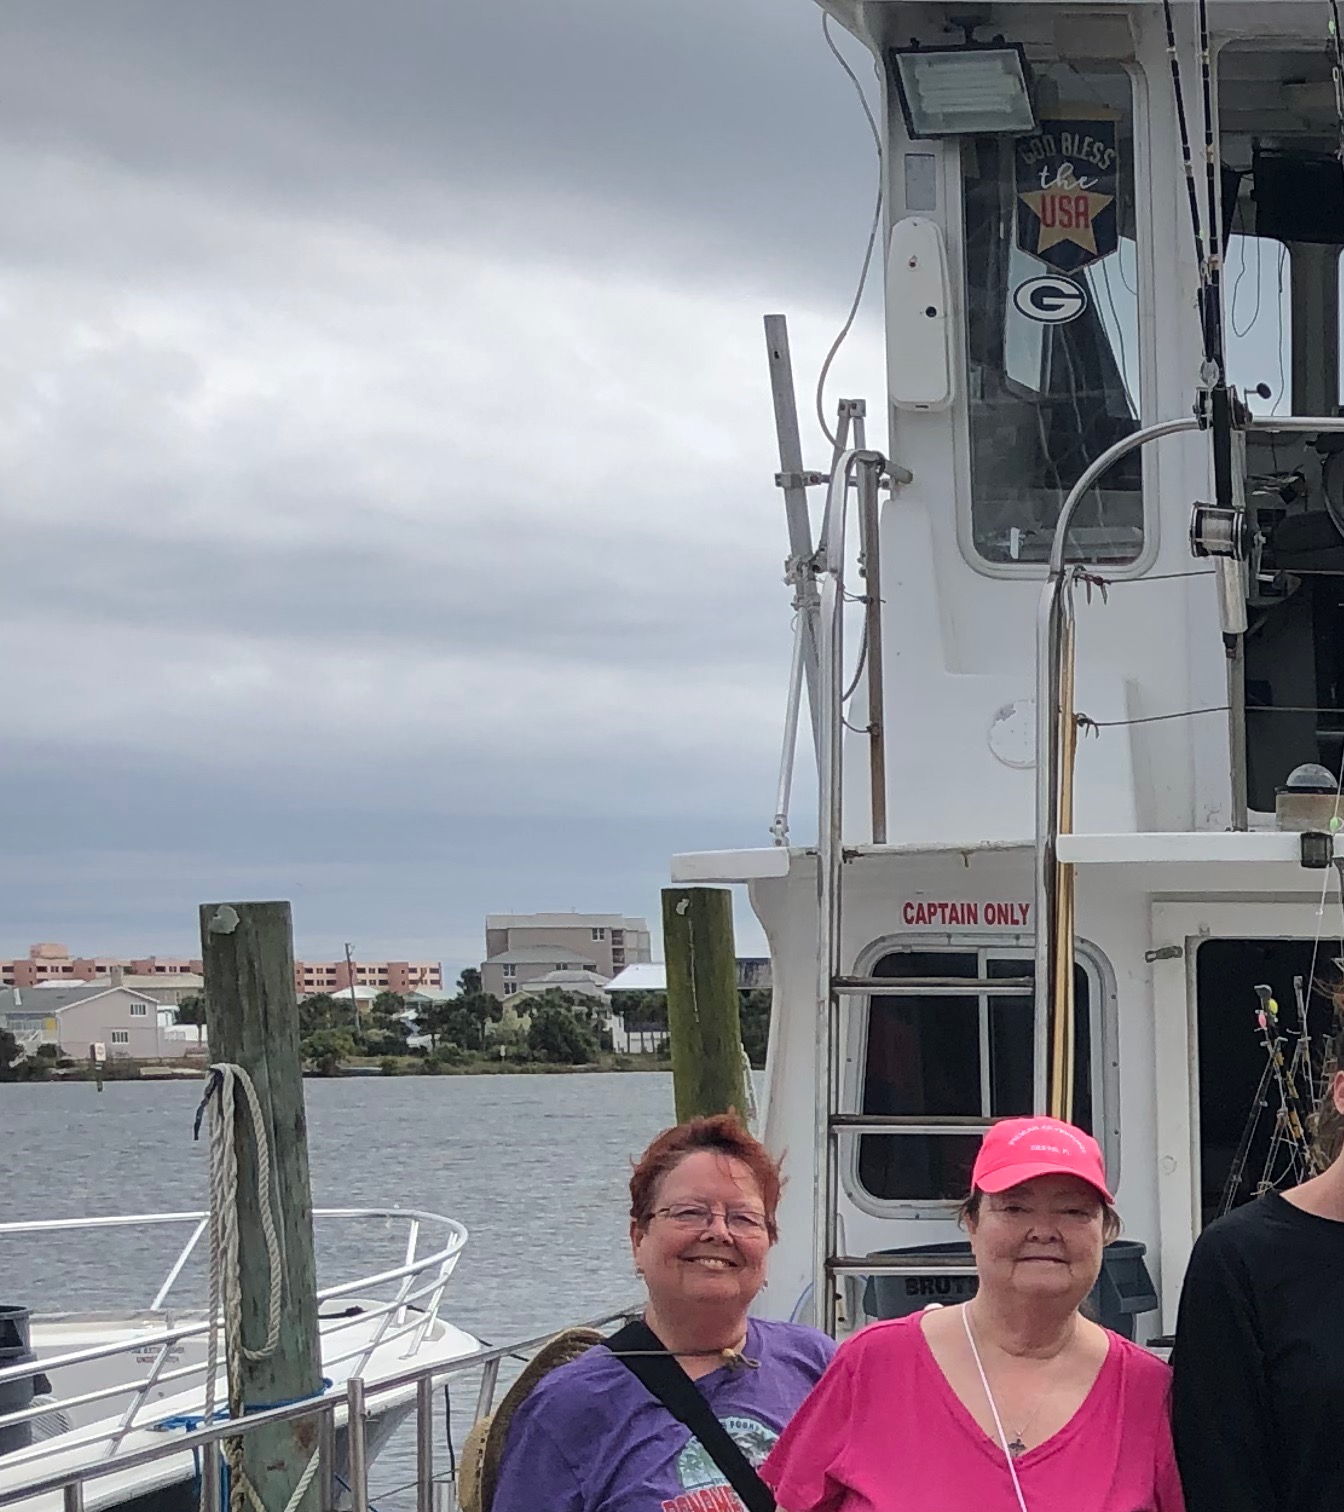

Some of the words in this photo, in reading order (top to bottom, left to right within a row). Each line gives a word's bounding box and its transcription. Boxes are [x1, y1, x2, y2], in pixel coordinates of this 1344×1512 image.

[1061, 132, 1117, 170] BLESS
[1039, 161, 1099, 190] the
[1041, 194, 1090, 230] USA
[903, 902, 978, 926] CAPTAIN
[984, 903, 1030, 926] ONLY
